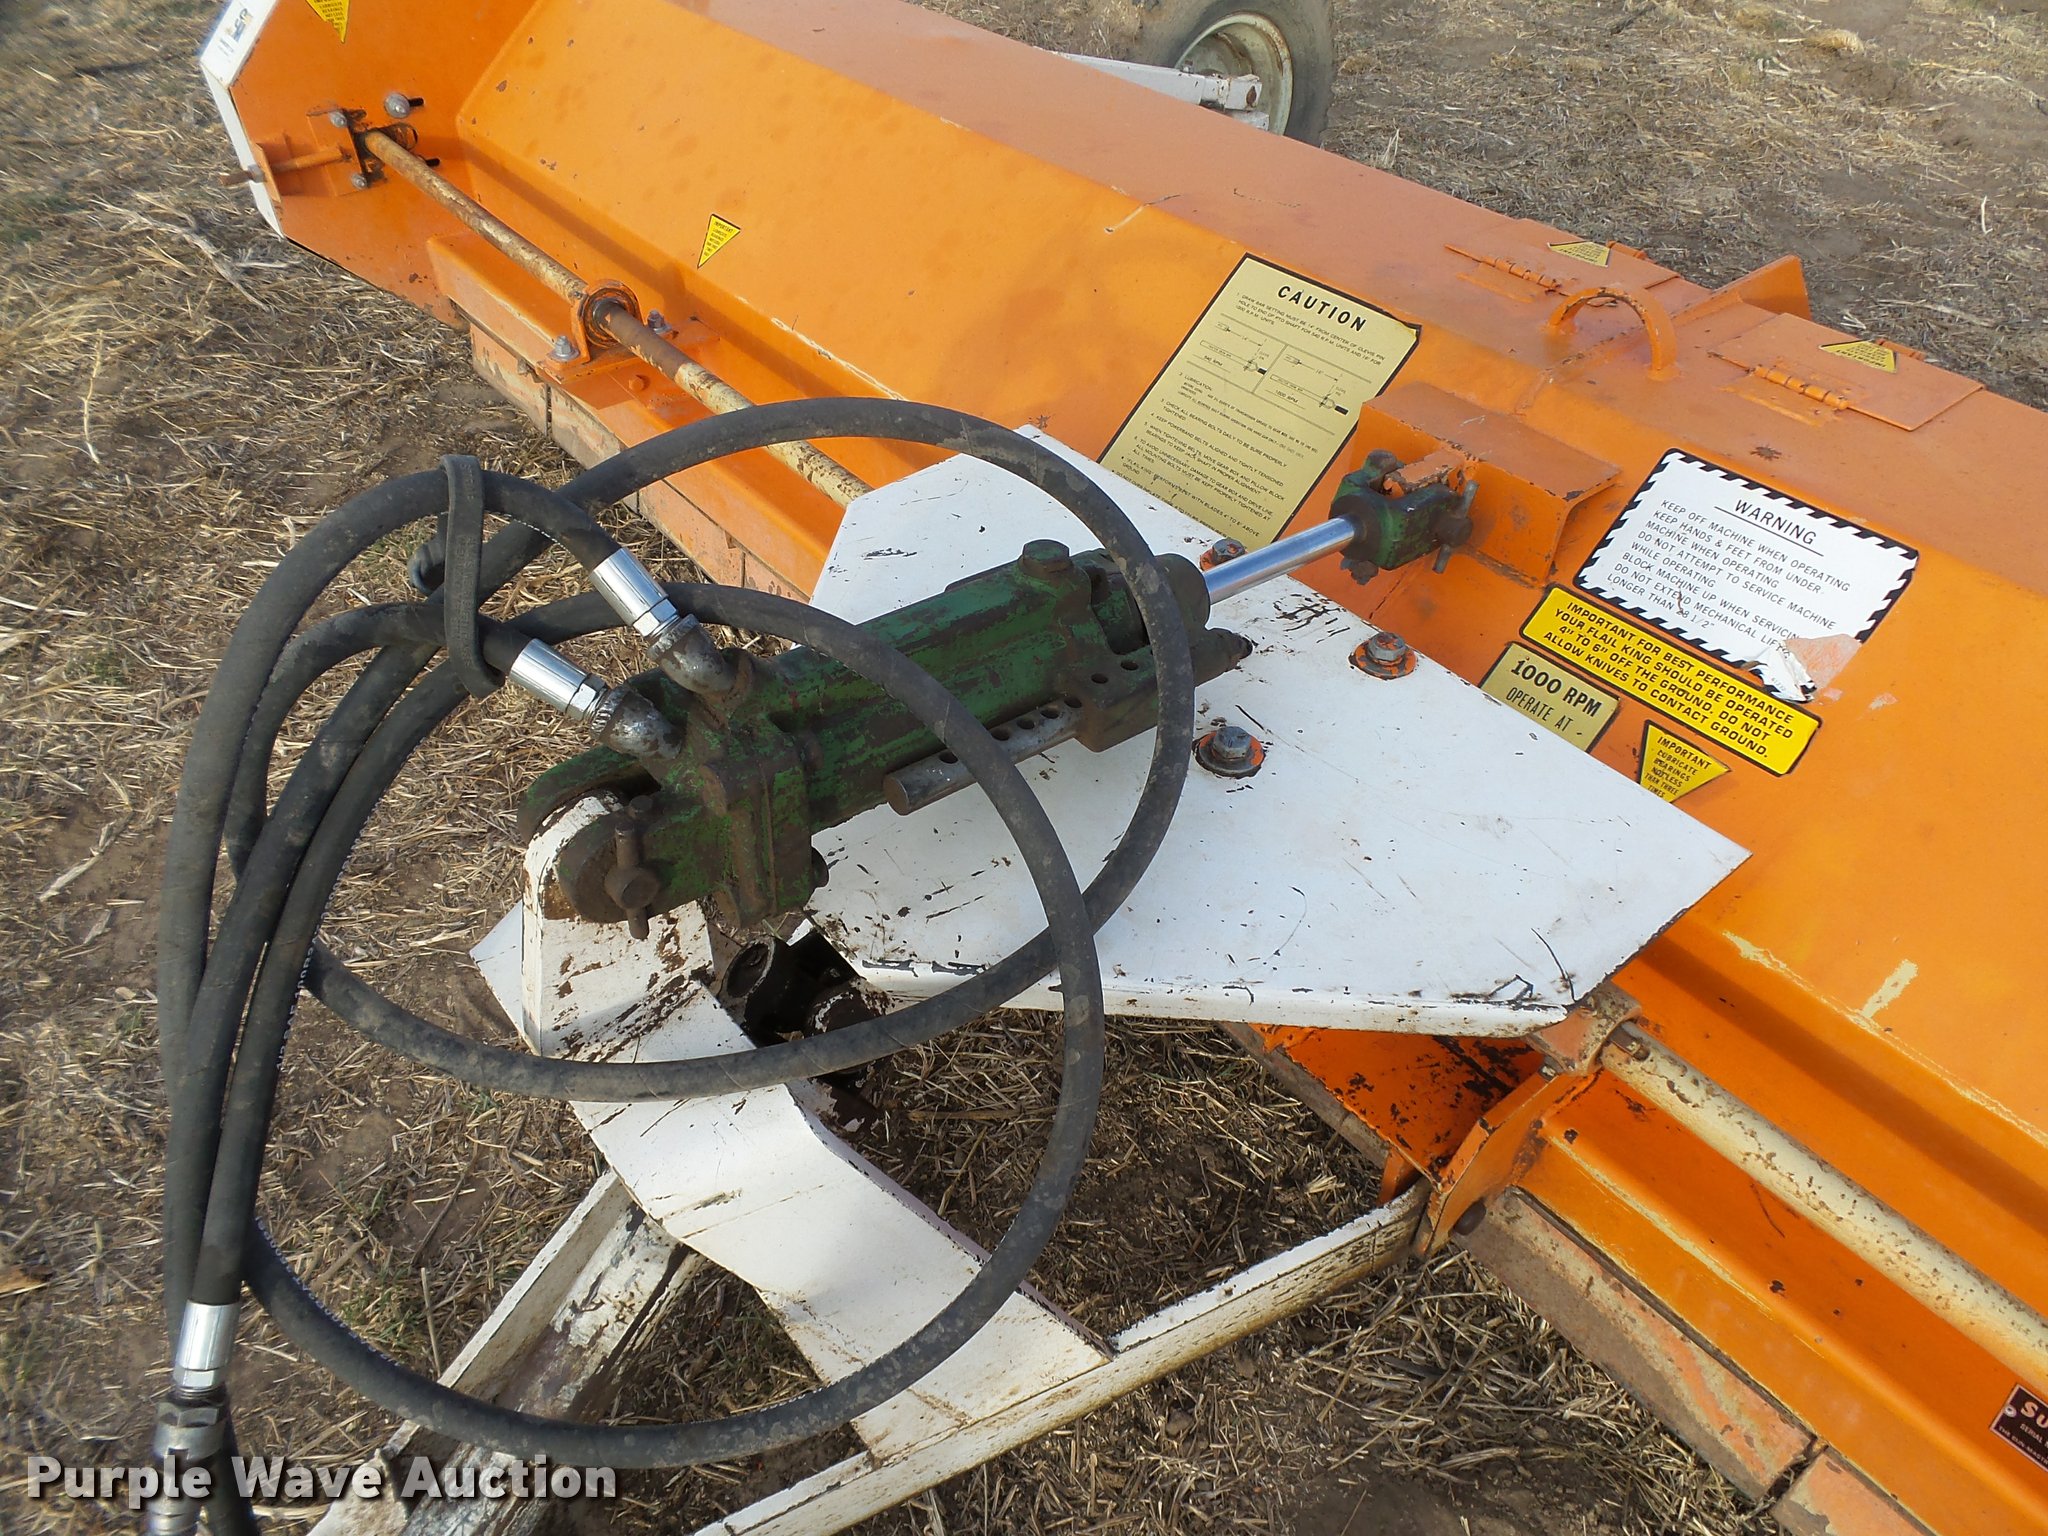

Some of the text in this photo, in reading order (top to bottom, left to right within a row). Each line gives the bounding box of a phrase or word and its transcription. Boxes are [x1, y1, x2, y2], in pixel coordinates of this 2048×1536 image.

[1275, 284, 1367, 332] CAUTION
[1329, 333, 1349, 344] CENTER
[1145, 429, 1166, 443] BEARINGS
[1172, 444, 1184, 453] KEEP
[1196, 457, 1210, 467] SHAFT
[1216, 468, 1235, 480] PROPER
[1149, 424, 1162, 433] WHEN
[1162, 431, 1188, 447] TIGHTENING
[1202, 454, 1216, 463] MOVE
[1216, 461, 1229, 470] GEAR
[1250, 480, 1268, 491] PILLOW
[1268, 490, 1284, 500] BLOCK
[1155, 415, 1167, 423] KEEP
[1193, 436, 1208, 446] BELTS
[1208, 444, 1228, 456] ALIGNED
[1238, 460, 1257, 472] TIGHTLY
[1165, 401, 1179, 410] CHECK
[1188, 413, 1207, 425] BEARING
[1207, 423, 1222, 433] BOLTS
[1222, 431, 1236, 440] DAILY
[1249, 446, 1262, 455] SURE
[1262, 452, 1287, 468] PROPERLY
[1144, 448, 1166, 463] MOUNTING
[1166, 461, 1181, 471] BOLTS
[1181, 469, 1194, 478] MUST
[1213, 487, 1237, 502] PROPERLY
[1145, 442, 1159, 451] AVOID
[1158, 449, 1190, 469] UNNECESSARY
[1189, 466, 1208, 479] DAMAGE
[1215, 481, 1228, 490] GEAR
[1237, 493, 1248, 501] AND
[1247, 499, 1262, 509] DRIVE
[1203, 502, 1223, 515] BLADES
[1242, 524, 1259, 536] ABOVE
[1659, 499, 1851, 592] KEEP OFF MACHINE WHEN OPERATING
[1732, 499, 1818, 545] WARNING
[1628, 541, 1716, 588] WHILE OPERATING
[1644, 520, 1780, 588] MACHINE WHEN OPERATING
[1651, 510, 1822, 594] KEEP HANDS & FEET FROM UNDER
[1605, 573, 1645, 597] LONGER
[1646, 593, 1674, 611] THAN
[1613, 562, 1629, 575] DO
[1629, 570, 1652, 586] NOT
[1652, 582, 1692, 606] EXTEND
[1692, 601, 1758, 638] MECHANICAL
[1621, 552, 1800, 642] BLOCK MACHINE UP WHEN SERVICIN
[1636, 530, 1837, 630] DO NOT ATTEMPT TO SERVICE MACHINE
[1510, 657, 1602, 717] 1000 RPM
[1552, 608, 1794, 739] YOUR FLAIL KING SHOULD BE OPERATED
[1557, 624, 1770, 742] 4" TO 6" OFF THE GROUND. DO NOT
[1566, 601, 1794, 724] IMPORTANT FOR BEST PERFORMANCE
[1505, 686, 1573, 733] OPERATE AT
[1542, 630, 1771, 758] ALLOW KNIVES TO CONTACT GROUND.
[1650, 765, 1683, 787] NOT LESS
[1653, 756, 1691, 782] BEARINGS
[1657, 735, 1711, 770] IMPORTANT
[1657, 748, 1698, 775] LUBRICATE
[1644, 772, 1678, 795] THAN THREE
[1647, 784, 1665, 798] TIMES
